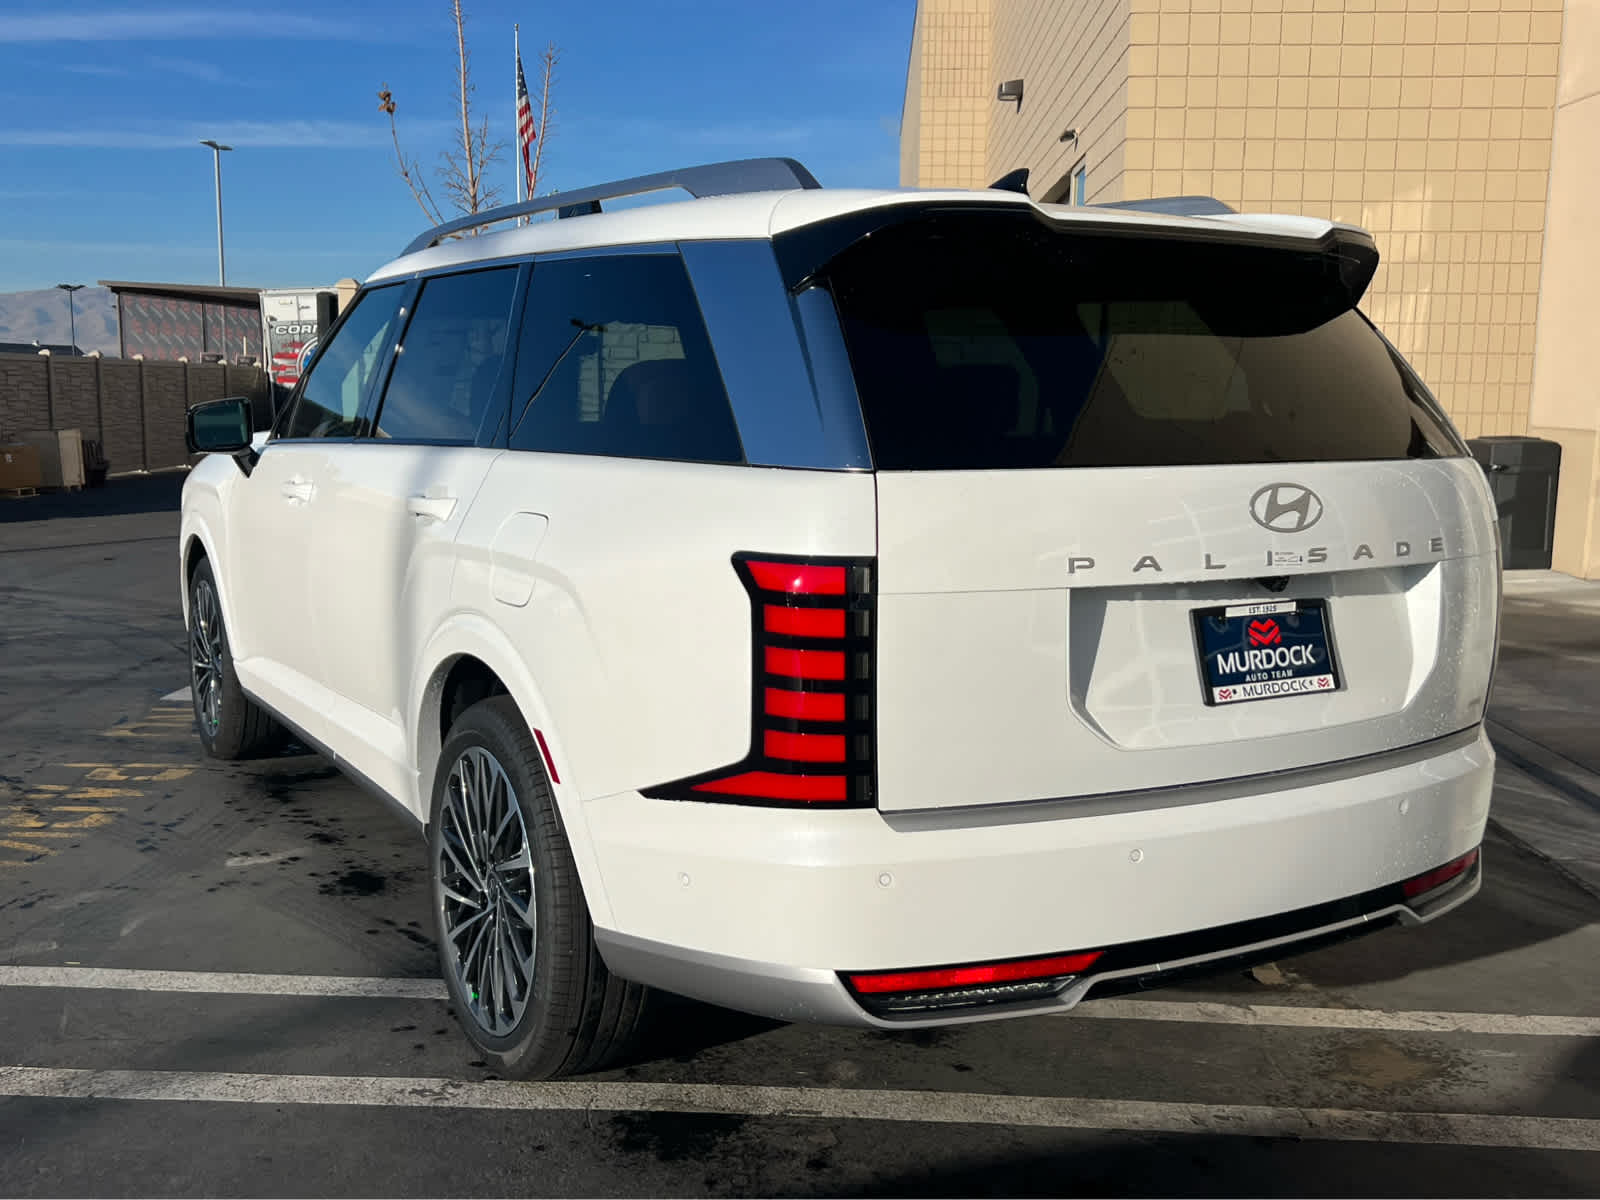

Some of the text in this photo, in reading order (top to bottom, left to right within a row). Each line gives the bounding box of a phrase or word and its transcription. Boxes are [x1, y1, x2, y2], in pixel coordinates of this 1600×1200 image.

[1067, 537, 1444, 575] PALISADE
[1216, 644, 1316, 675] MURDOCK
[1245, 669, 1293, 682] AUTO TEAM
[1242, 679, 1309, 697] MURDOCK
